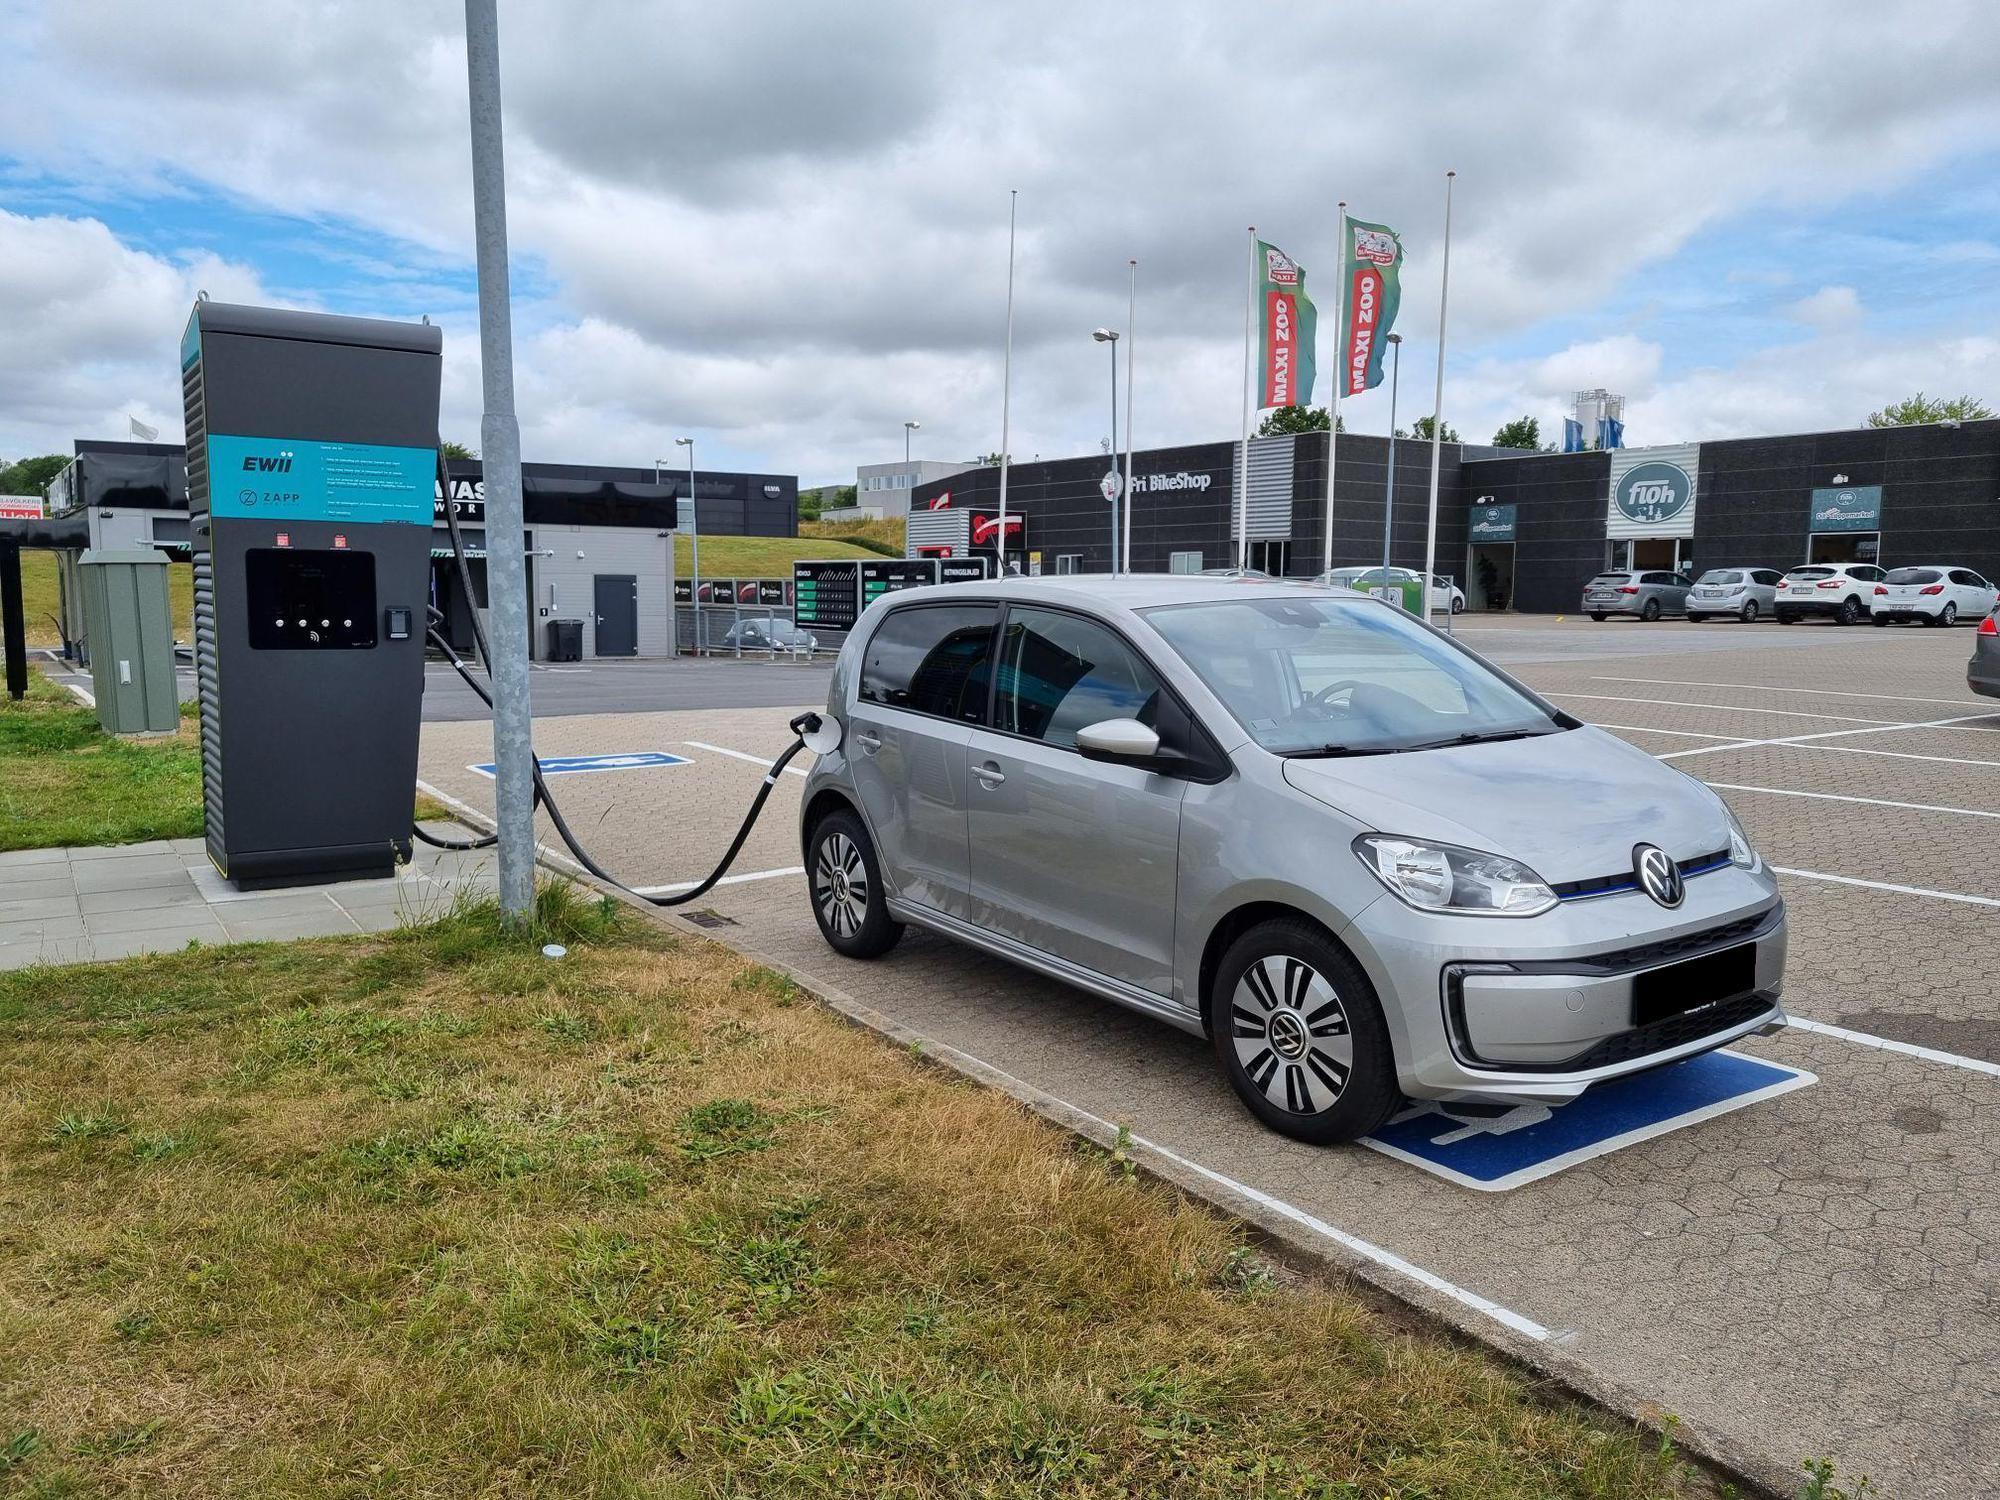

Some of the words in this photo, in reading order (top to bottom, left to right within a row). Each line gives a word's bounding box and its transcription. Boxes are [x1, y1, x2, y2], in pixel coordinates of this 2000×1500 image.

[1275, 298, 1289, 341] ZOO
[1358, 276, 1375, 324] ZOO
[1272, 347, 1288, 403] MAXI
[1352, 330, 1371, 390] MAXI
[263, 492, 300, 503] ZAPP
[1130, 477, 1147, 493] Fri
[1150, 472, 1211, 492] BikeShop
